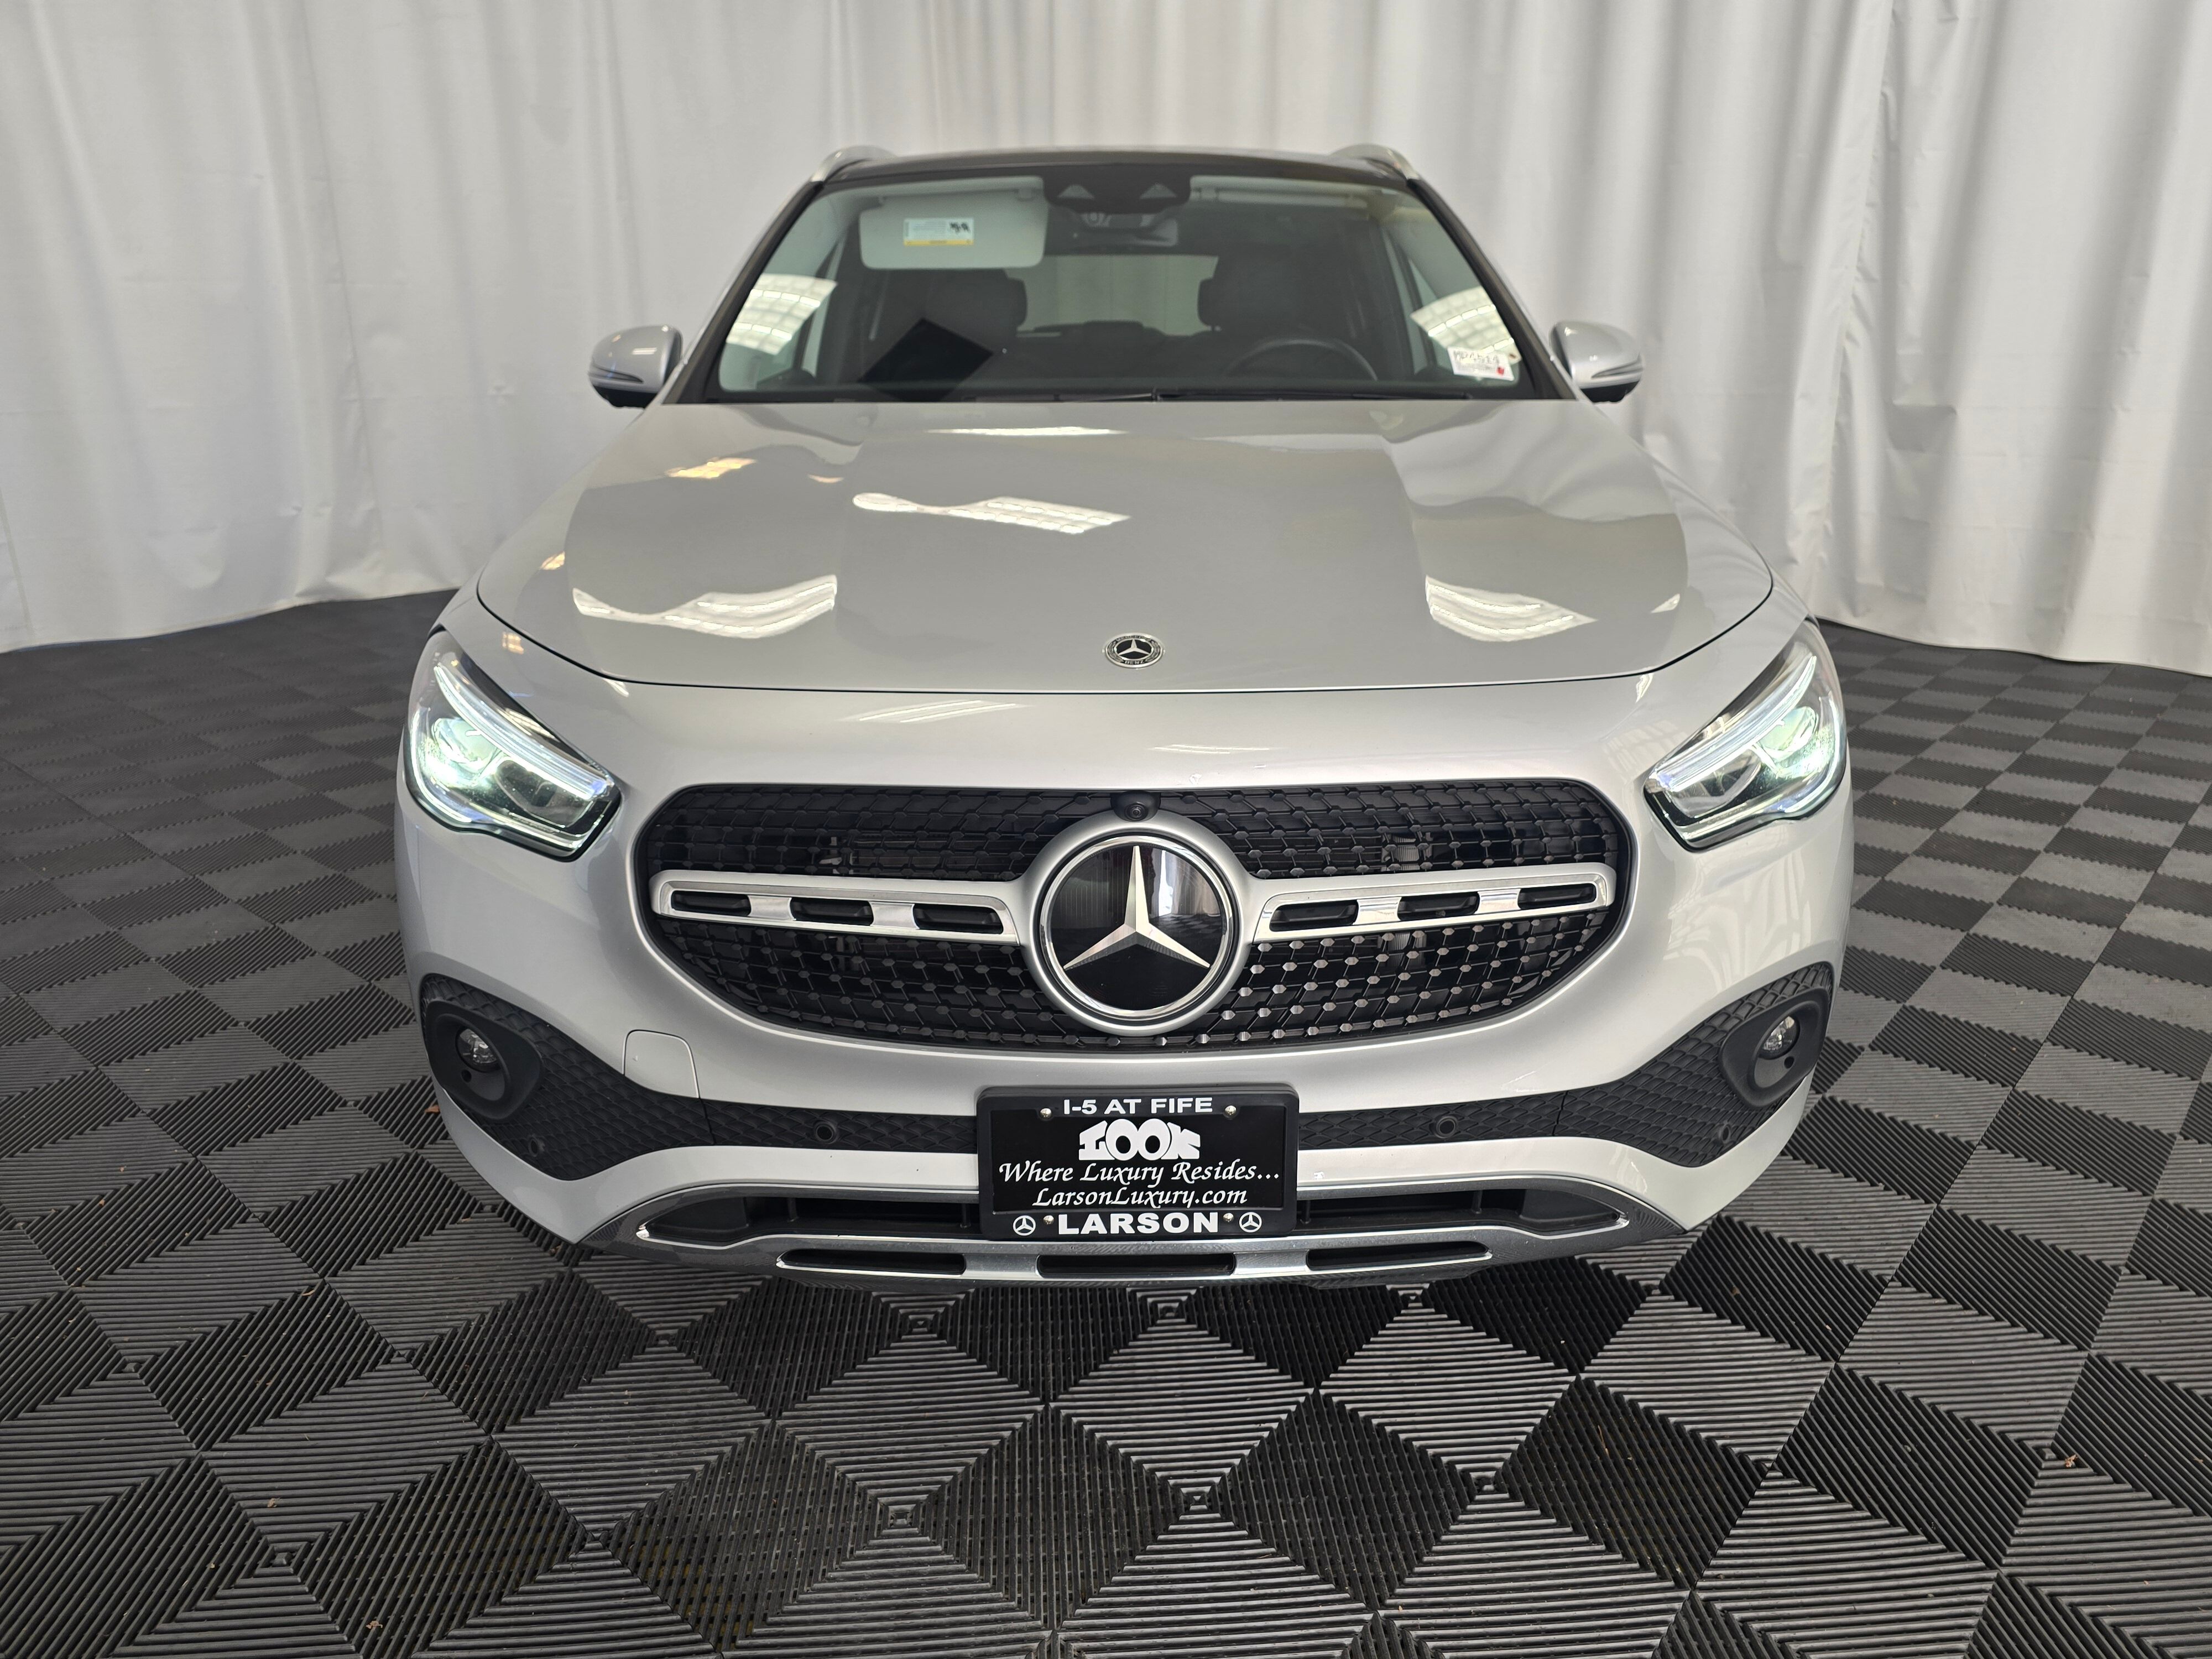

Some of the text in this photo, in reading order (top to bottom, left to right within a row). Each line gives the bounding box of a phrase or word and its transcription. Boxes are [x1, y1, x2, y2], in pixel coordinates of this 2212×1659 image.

[1064, 1097, 1213, 1115] I-5 AT FIFE
[999, 1159, 1279, 1188] Where Luxury Resides...
[1032, 1187, 1248, 1209] LarsonLuxury.com
[1058, 1212, 1218, 1235] LARSON
